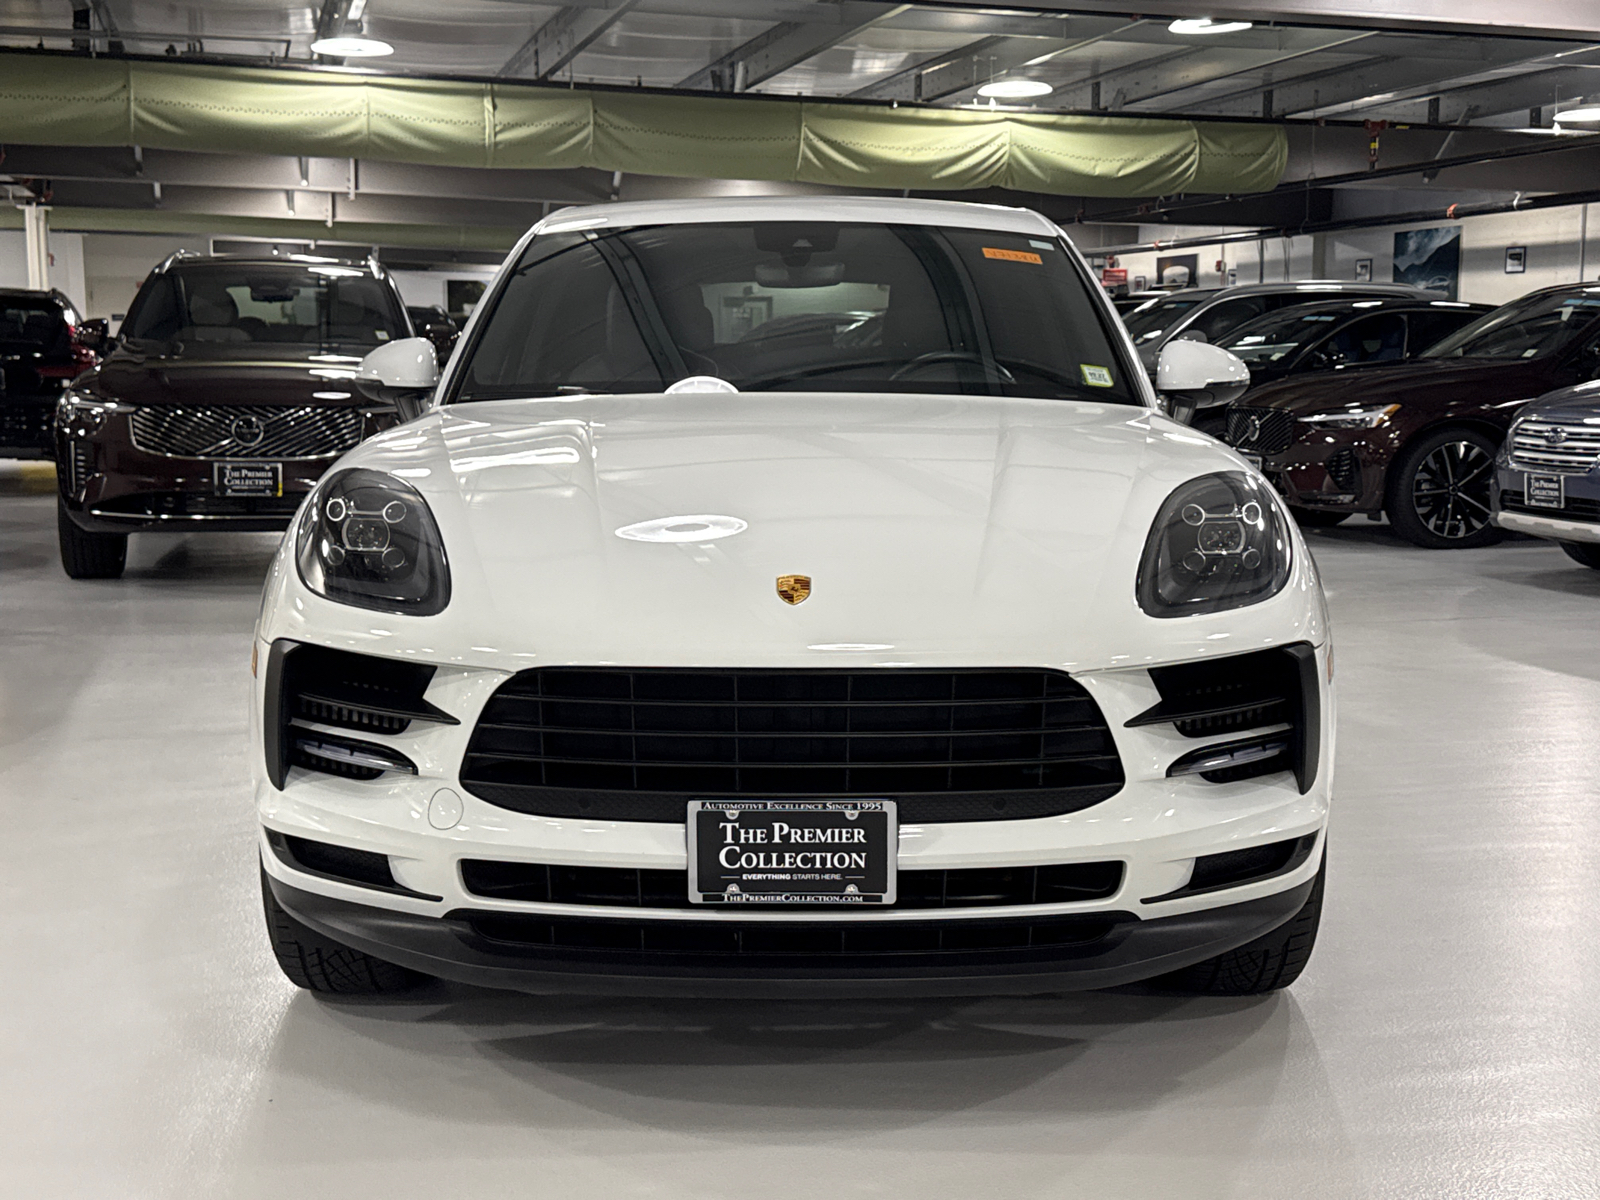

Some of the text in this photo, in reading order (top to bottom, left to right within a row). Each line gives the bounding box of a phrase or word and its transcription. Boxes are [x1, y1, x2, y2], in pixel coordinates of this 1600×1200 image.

[703, 802, 882, 811] AUTOMOTIVE EXCELLENCE SINCE 1995
[719, 822, 867, 844] THE PREMIER
[719, 845, 867, 869] COLLECTION
